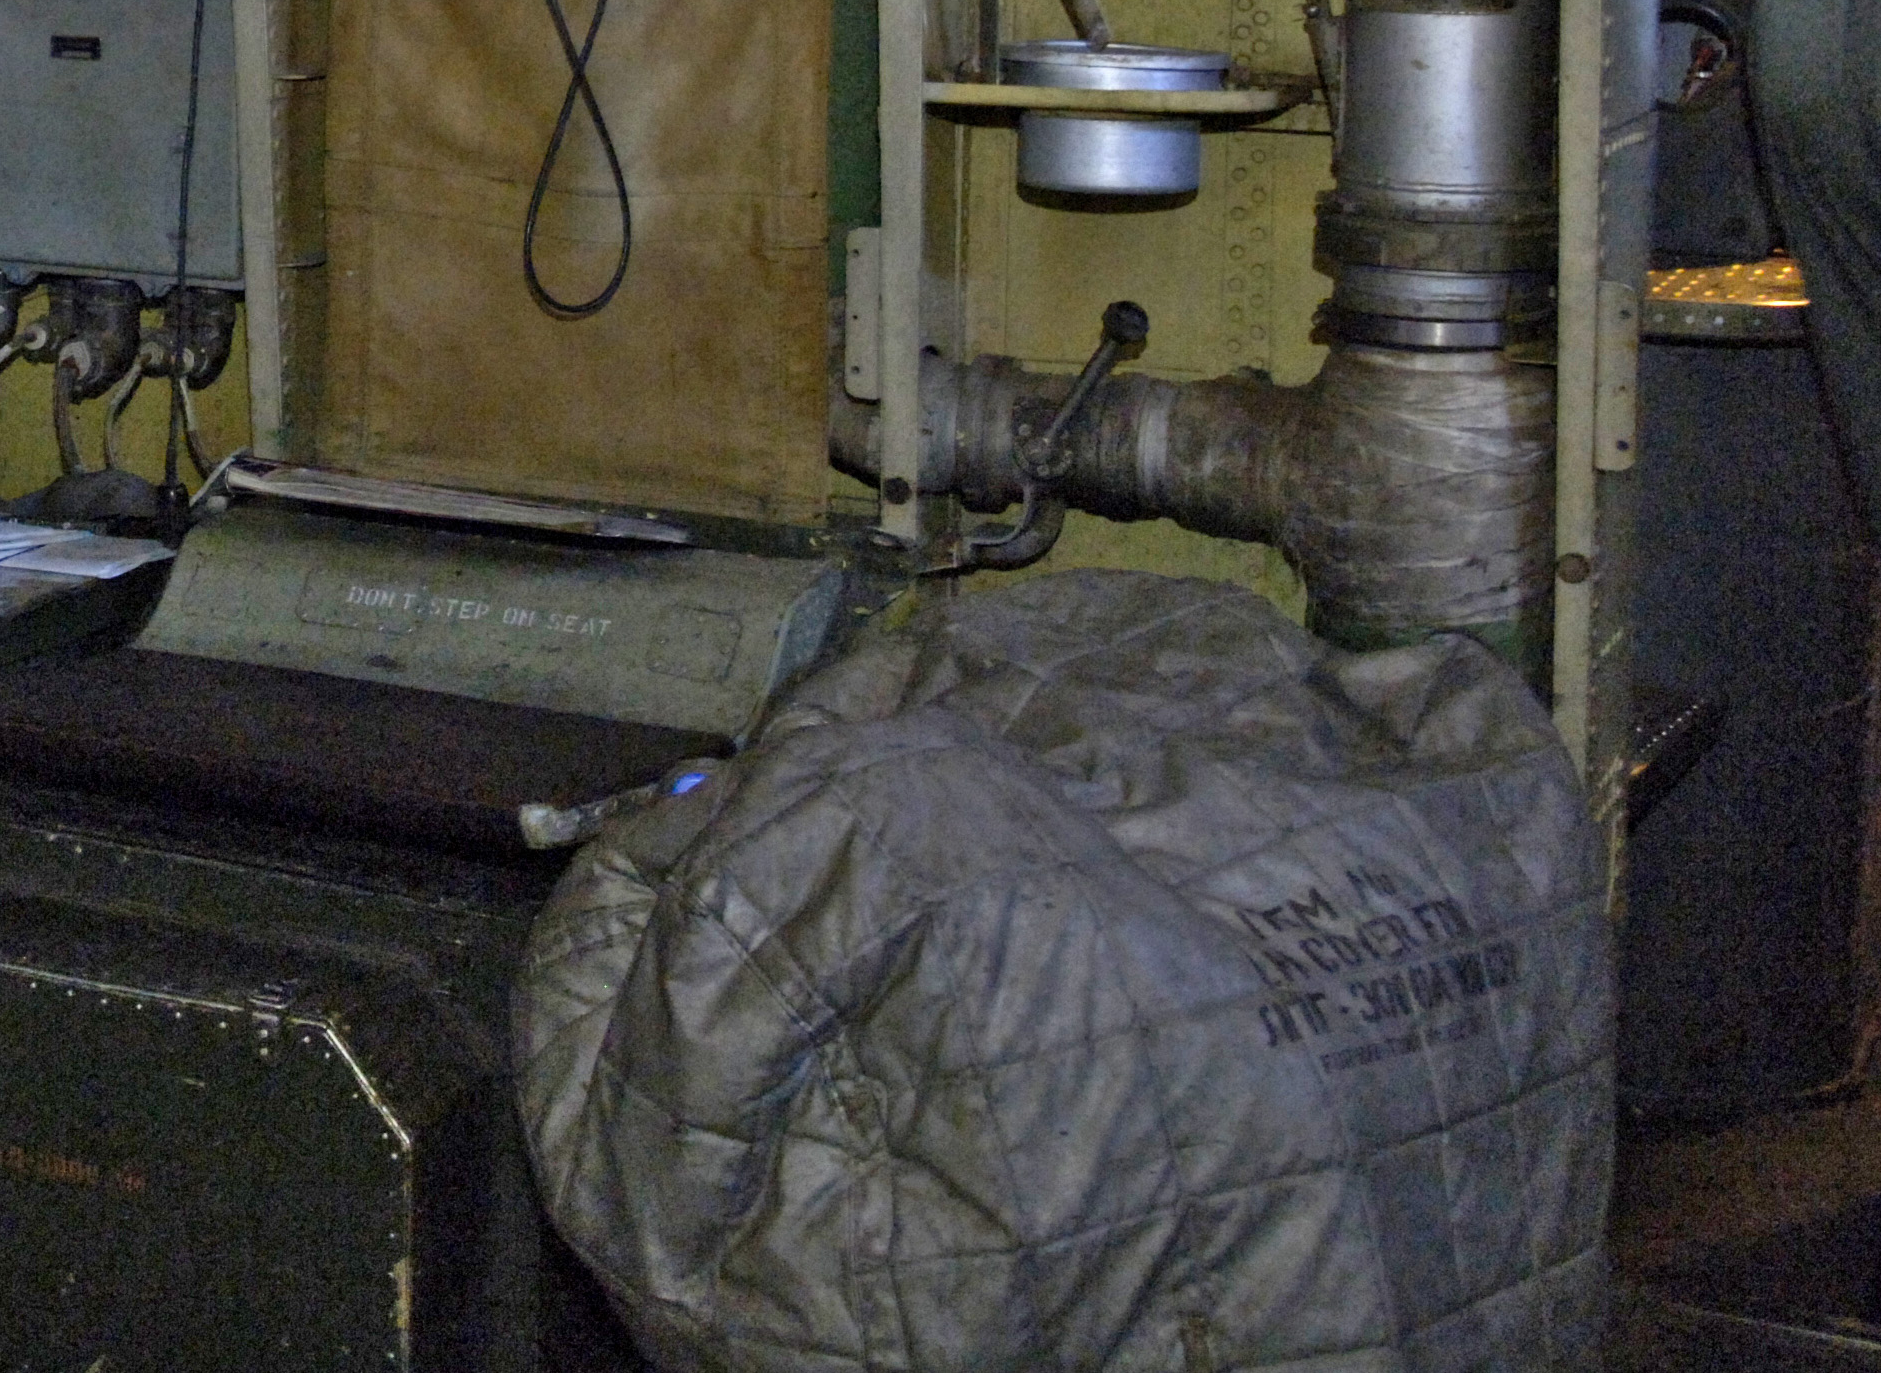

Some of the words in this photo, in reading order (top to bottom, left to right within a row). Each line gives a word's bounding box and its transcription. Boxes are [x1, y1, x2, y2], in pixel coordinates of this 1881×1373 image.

[429, 597, 490, 620] STEP
[503, 605, 536, 627] ON
[547, 611, 612, 637] SEAT
